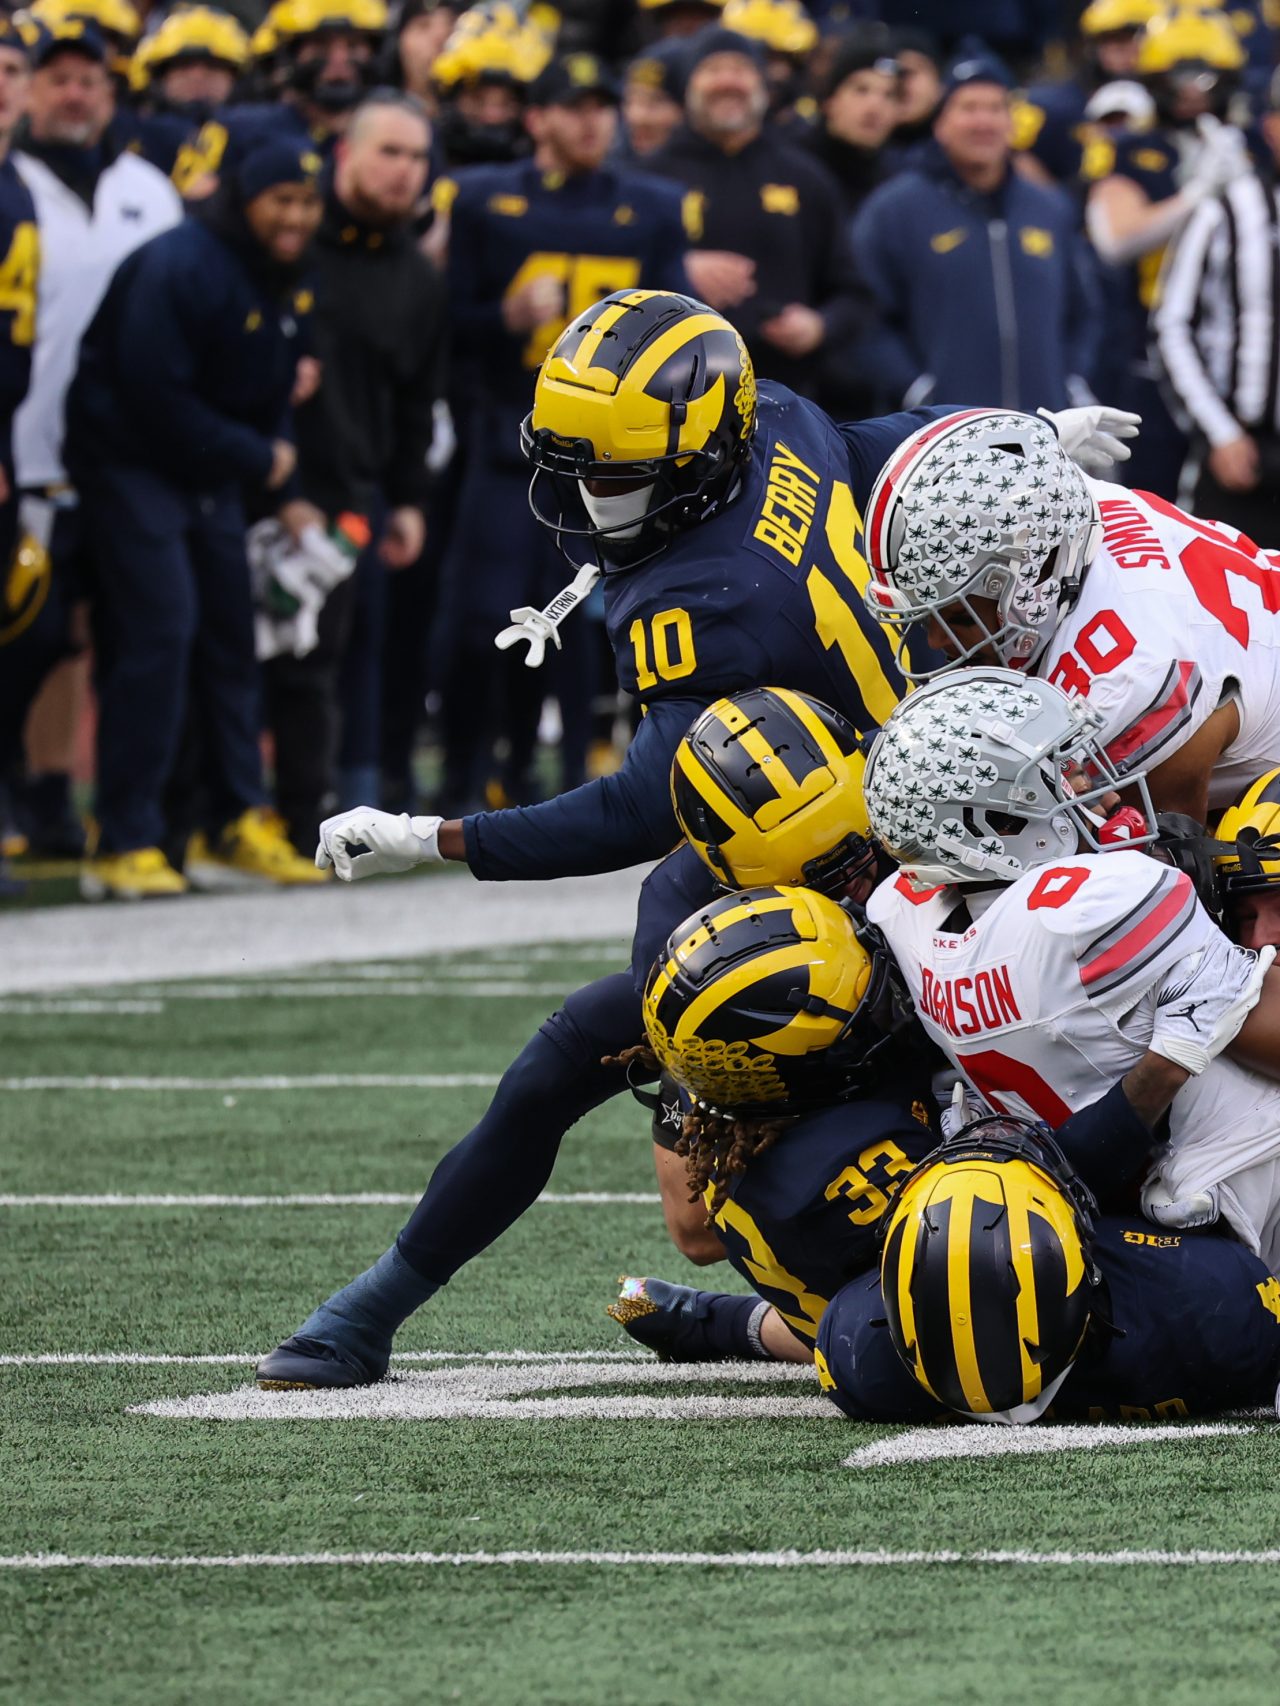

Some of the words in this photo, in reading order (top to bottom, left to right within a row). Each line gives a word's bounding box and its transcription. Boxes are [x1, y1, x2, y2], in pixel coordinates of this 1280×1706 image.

[753, 440, 821, 567] BERRY
[1097, 499, 1171, 570] SIMON
[545, 591, 578, 622] NXTRND
[629, 607, 697, 691] 10
[1048, 608, 1138, 699] 30
[1027, 866, 1092, 910] 0
[824, 1140, 917, 1226] 33
